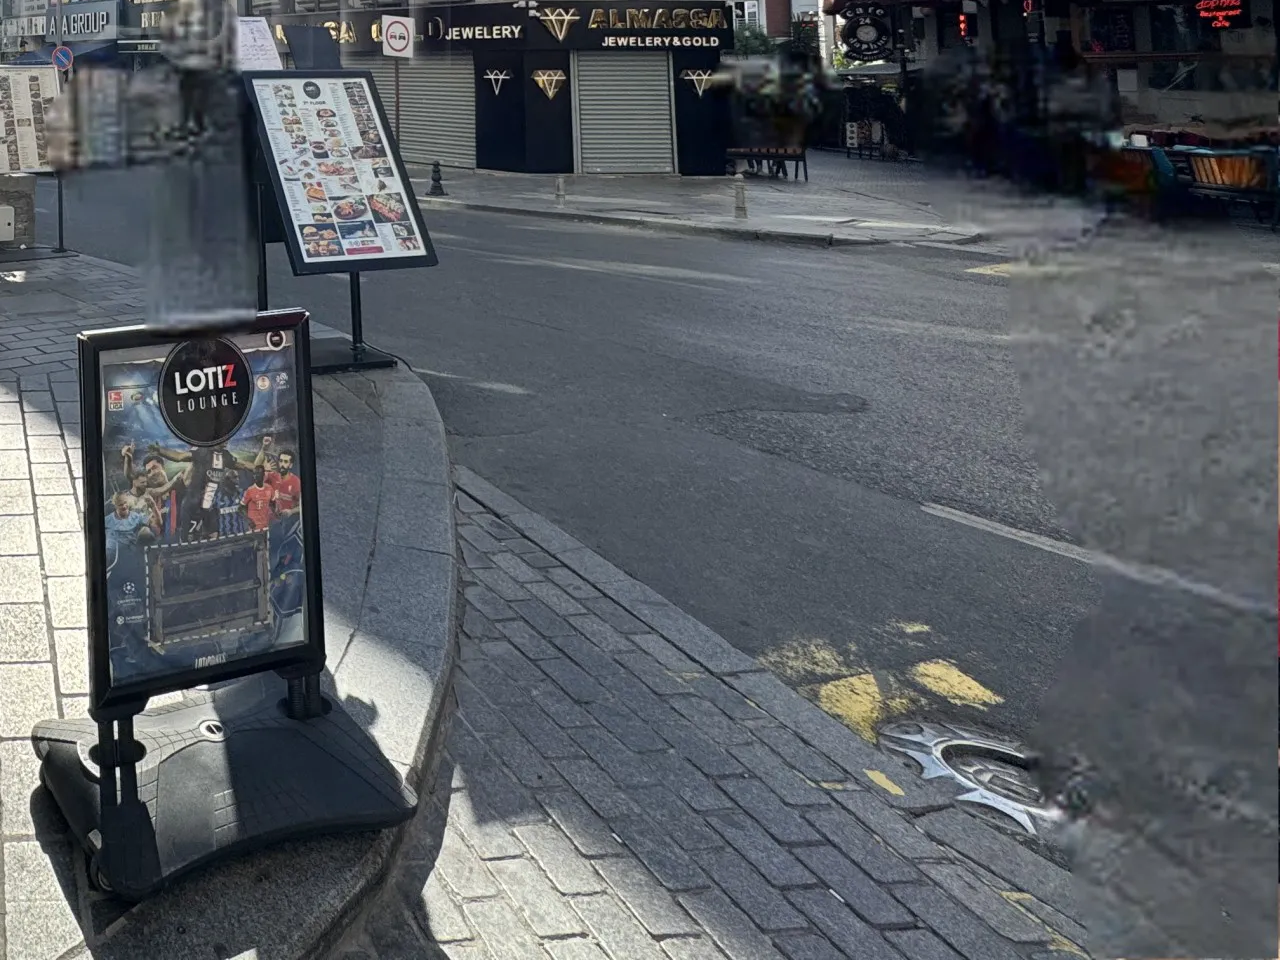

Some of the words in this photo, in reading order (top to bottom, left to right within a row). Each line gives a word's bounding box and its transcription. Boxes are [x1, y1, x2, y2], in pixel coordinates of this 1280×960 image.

[71, 12, 107, 35] GROUP
[445, 24, 521, 40] JEWELERY
[601, 36, 719, 47] JEWELERY&GOLD
[174, 364, 237, 395] LOTIZ
[177, 392, 239, 413] LOUNGE
